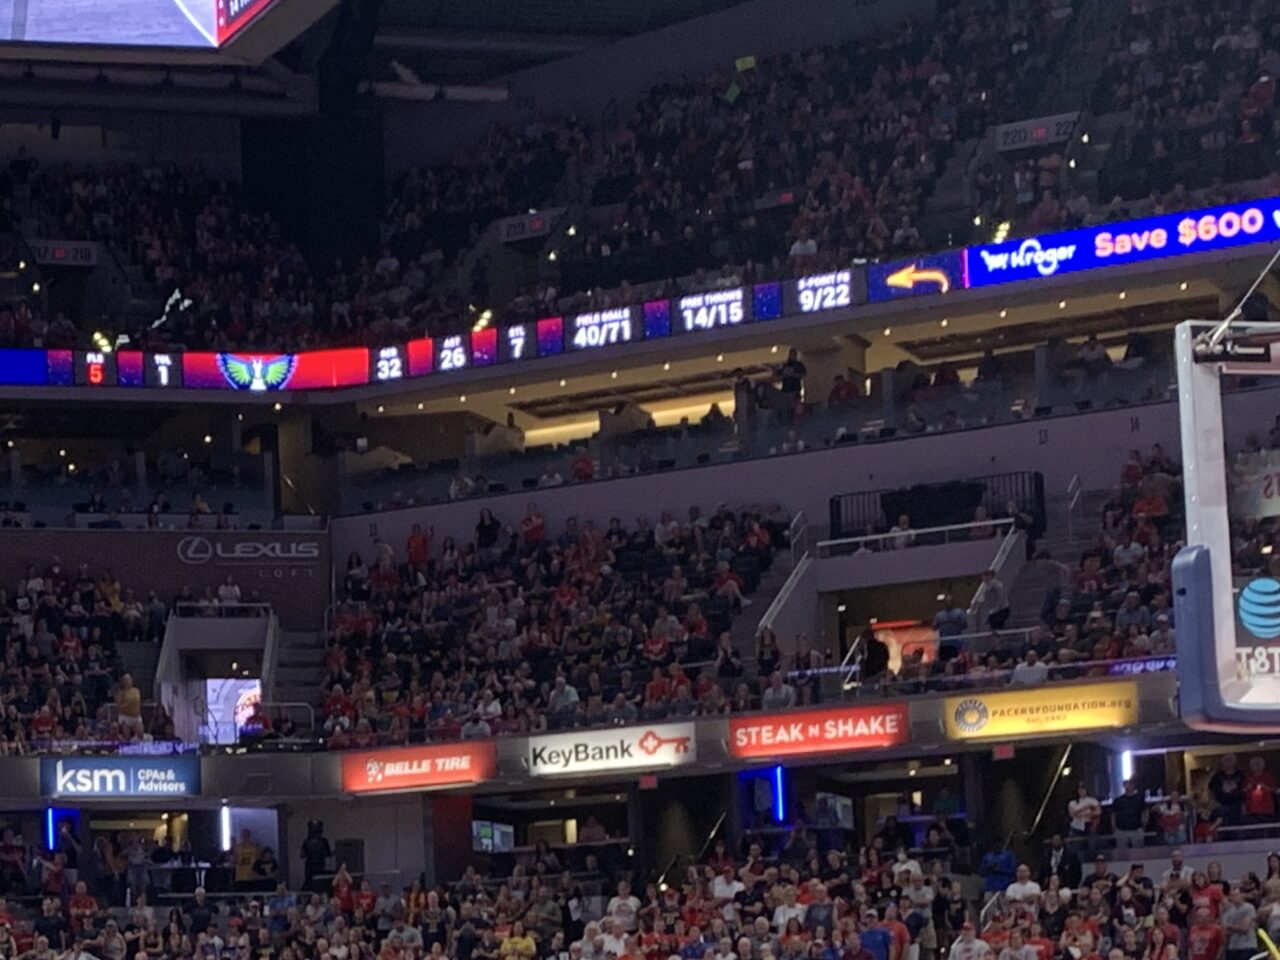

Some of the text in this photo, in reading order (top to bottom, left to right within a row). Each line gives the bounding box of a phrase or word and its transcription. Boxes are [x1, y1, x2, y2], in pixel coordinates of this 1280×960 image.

[1094, 207, 1265, 258] Save $600
[798, 284, 851, 313] 9/22
[682, 301, 744, 332] 14/15
[573, 320, 632, 349] 40/71
[439, 346, 467, 371] 26
[510, 337, 525, 359] 7
[88, 364, 104, 384] 5
[157, 365, 169, 386] 1
[376, 358, 403, 381] 32
[215, 541, 320, 559] LEXUS
[736, 714, 899, 747] STEAK N SHAKE
[531, 739, 634, 768] KeyBank
[56, 760, 126, 793] ksm
[137, 769, 175, 781] CPAs &
[383, 755, 472, 777] BELLE TIRE
[137, 781, 186, 793] Advisors
